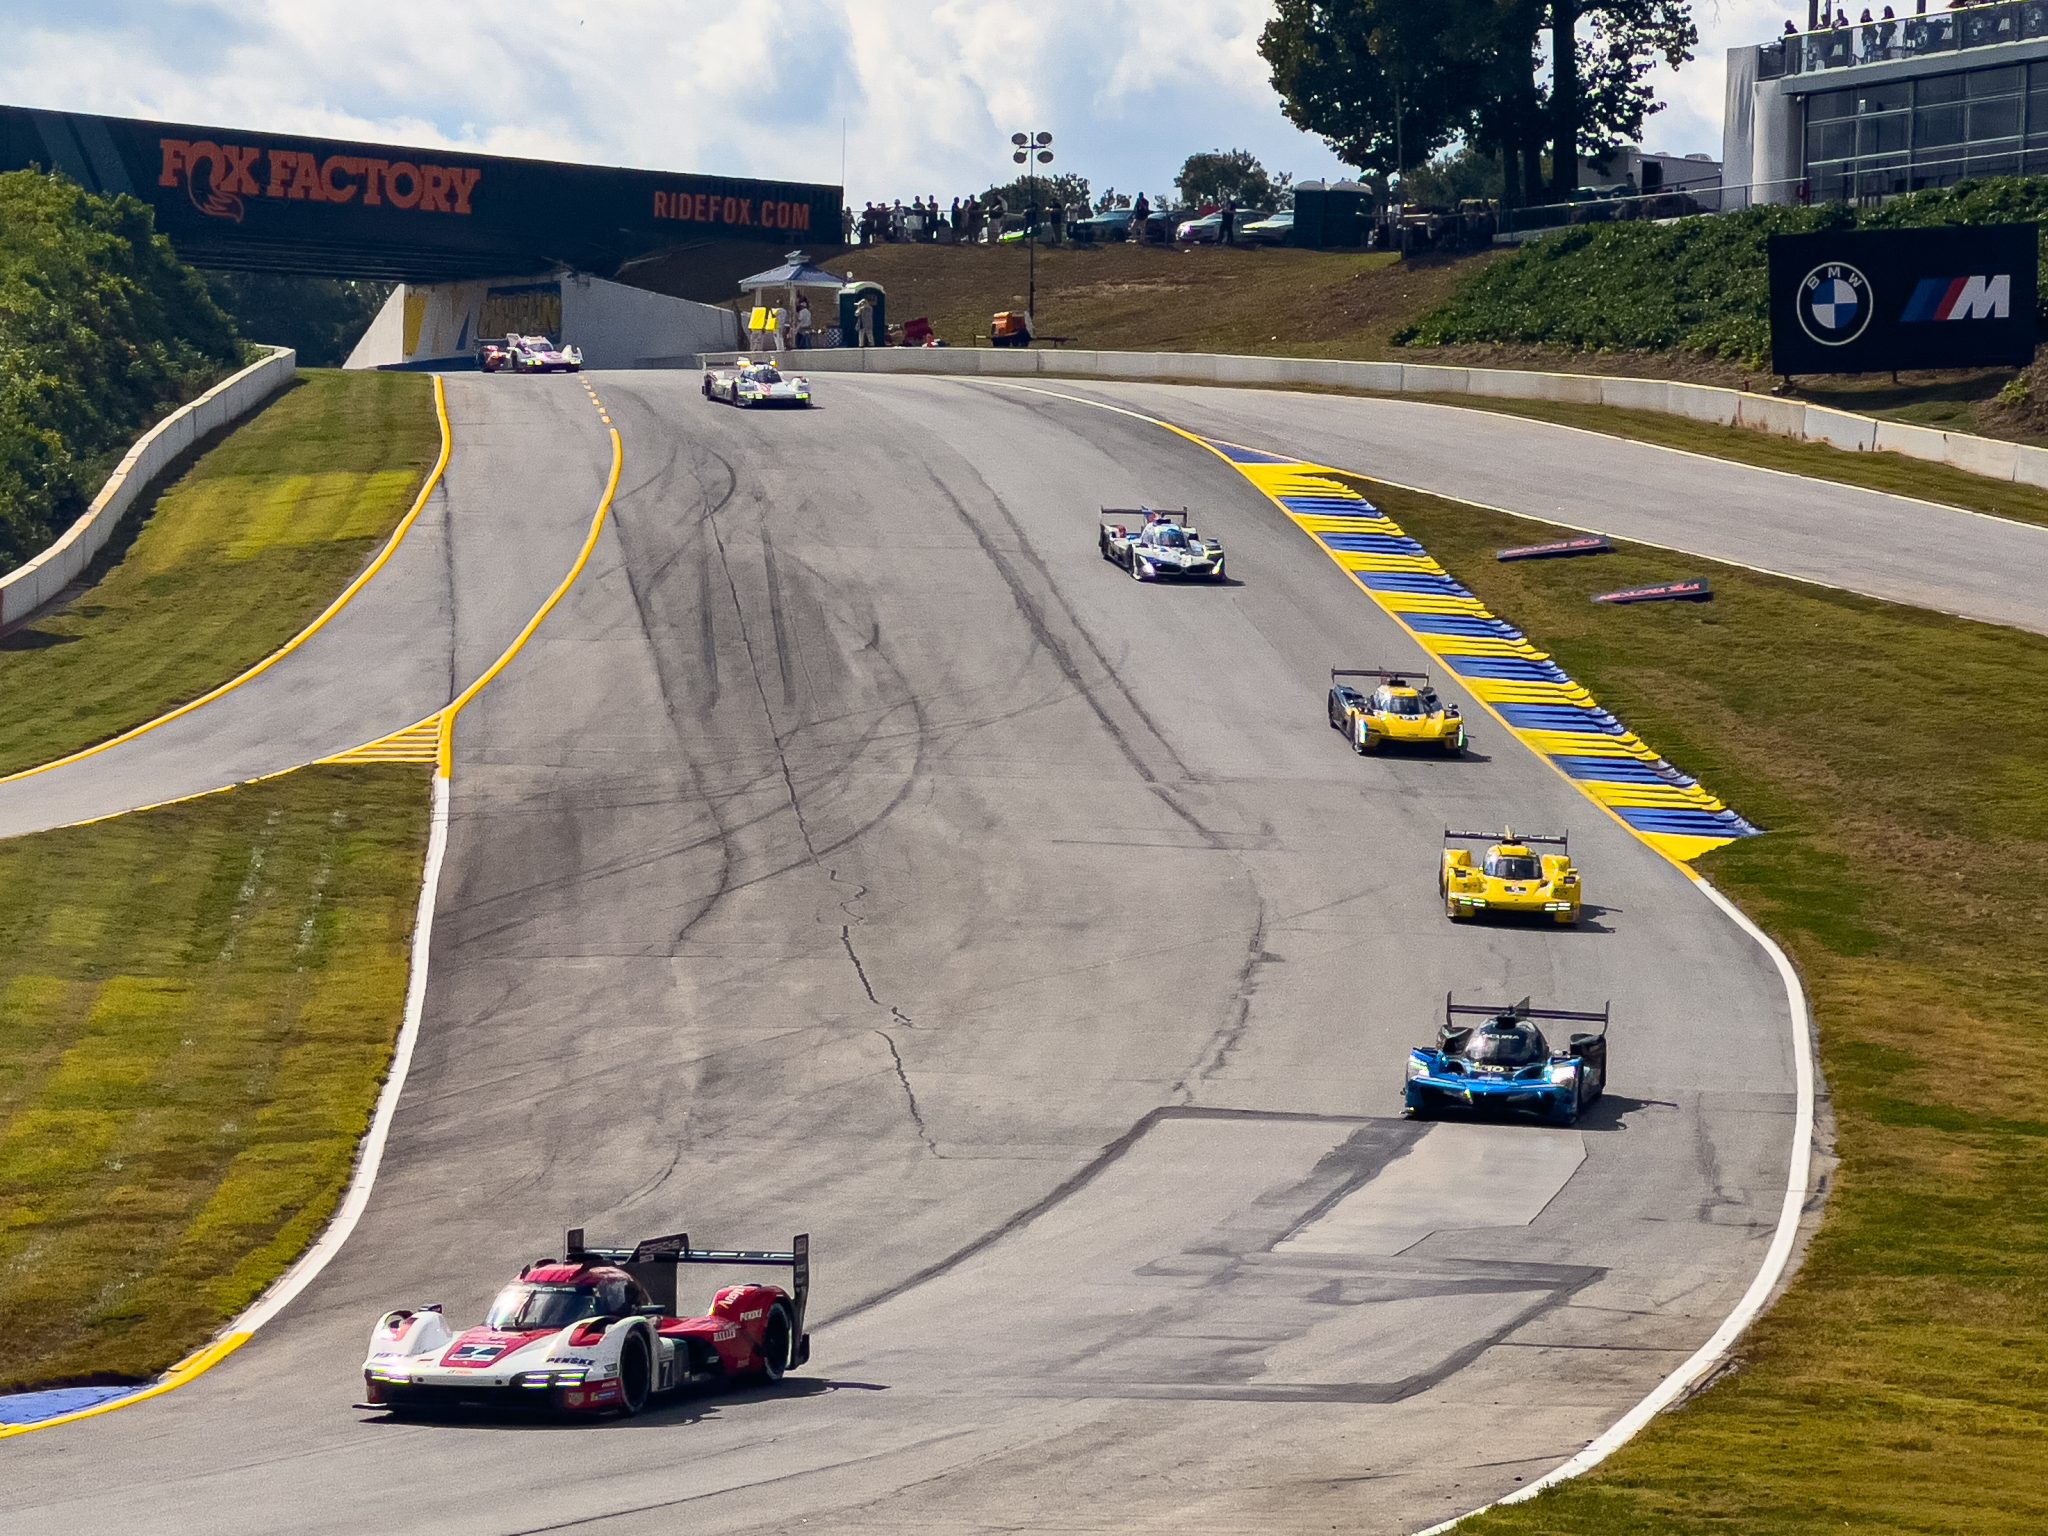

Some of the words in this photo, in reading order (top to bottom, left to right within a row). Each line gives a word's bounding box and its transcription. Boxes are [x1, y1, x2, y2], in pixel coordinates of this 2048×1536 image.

[158, 138, 261, 214] FOX
[267, 150, 481, 214] FACTORY
[654, 191, 811, 230] RIDEFOX.COM
[1806, 265, 1863, 291] BMW
[546, 1357, 596, 1366] PENSKE
[662, 1360, 670, 1387] 7
